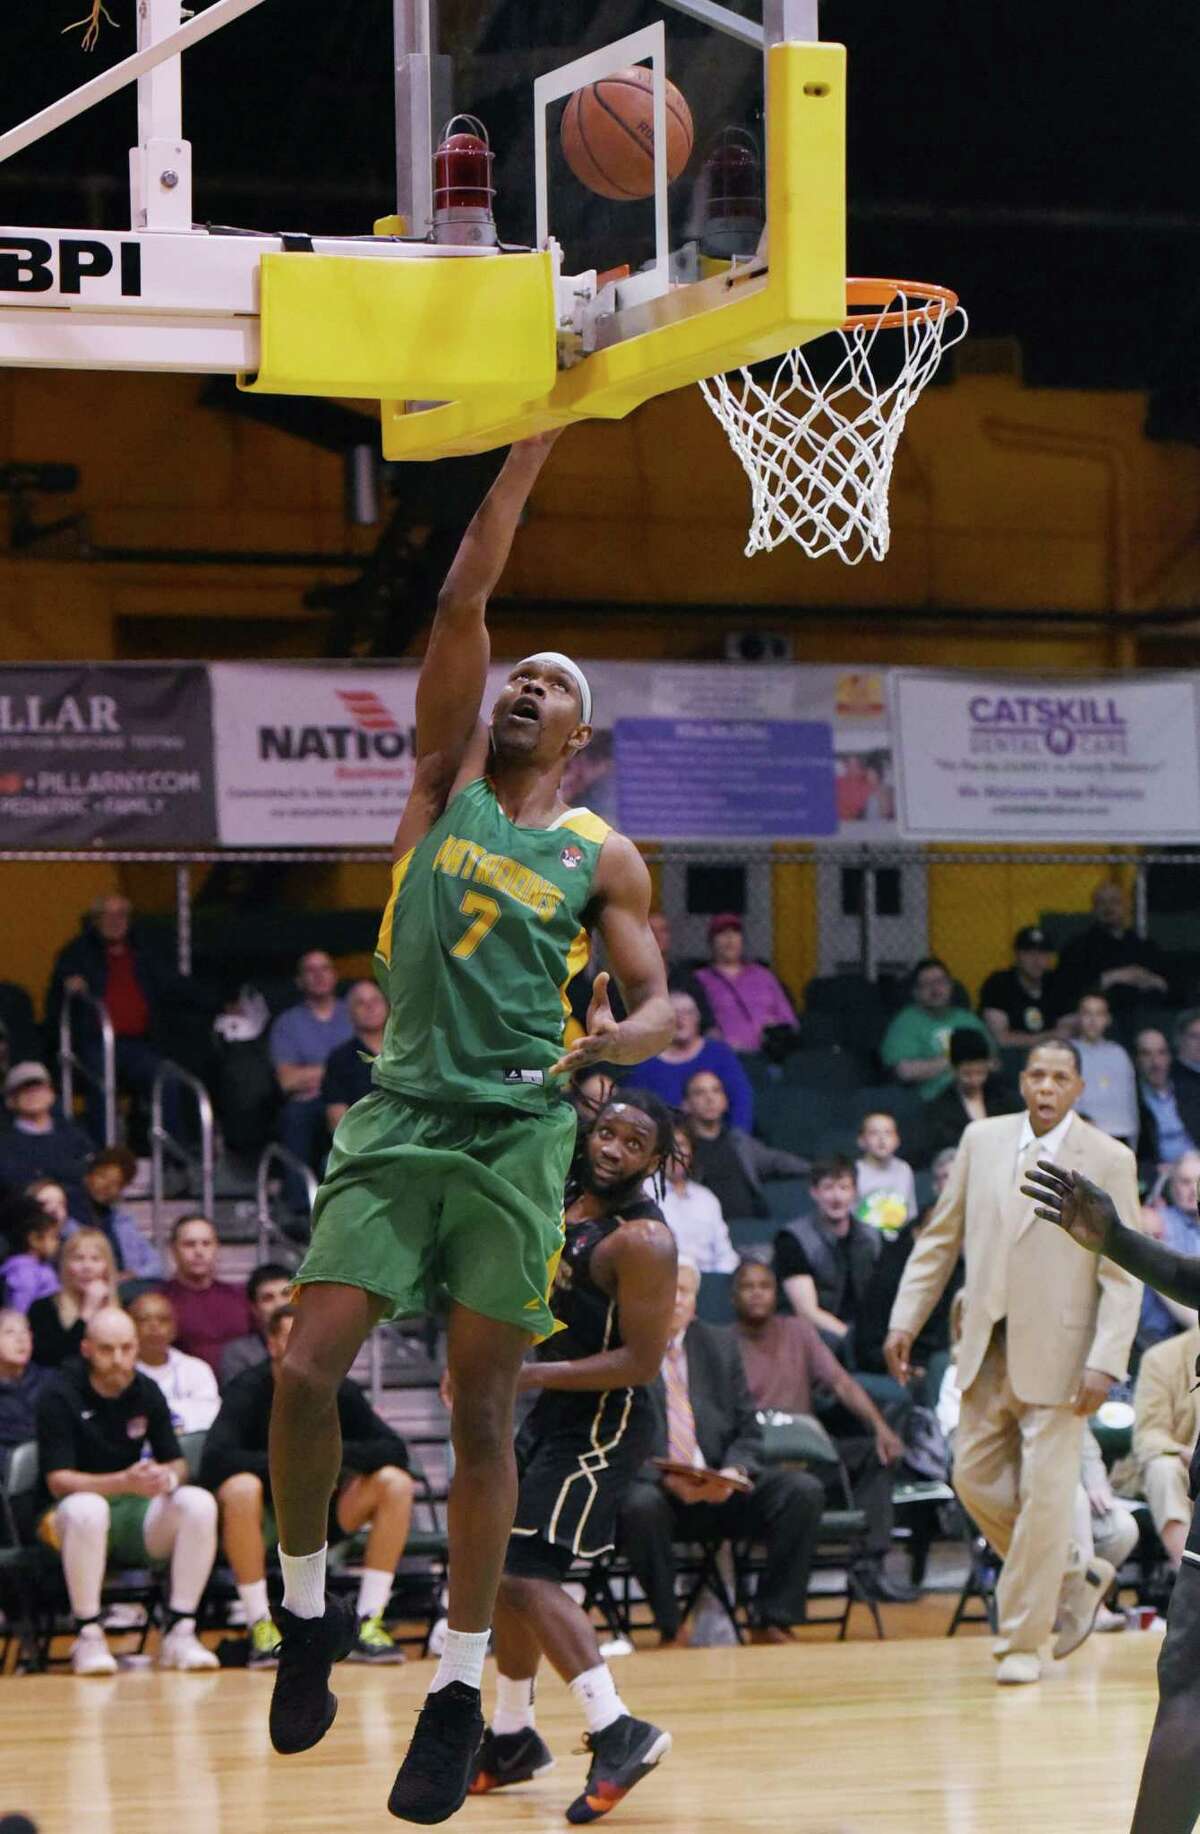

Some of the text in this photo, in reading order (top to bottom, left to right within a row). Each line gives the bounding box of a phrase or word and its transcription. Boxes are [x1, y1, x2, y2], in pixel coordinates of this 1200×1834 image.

[968, 697, 1126, 725] CATSKILL
[258, 725, 417, 761] NATIO
[449, 889, 502, 961] 7
